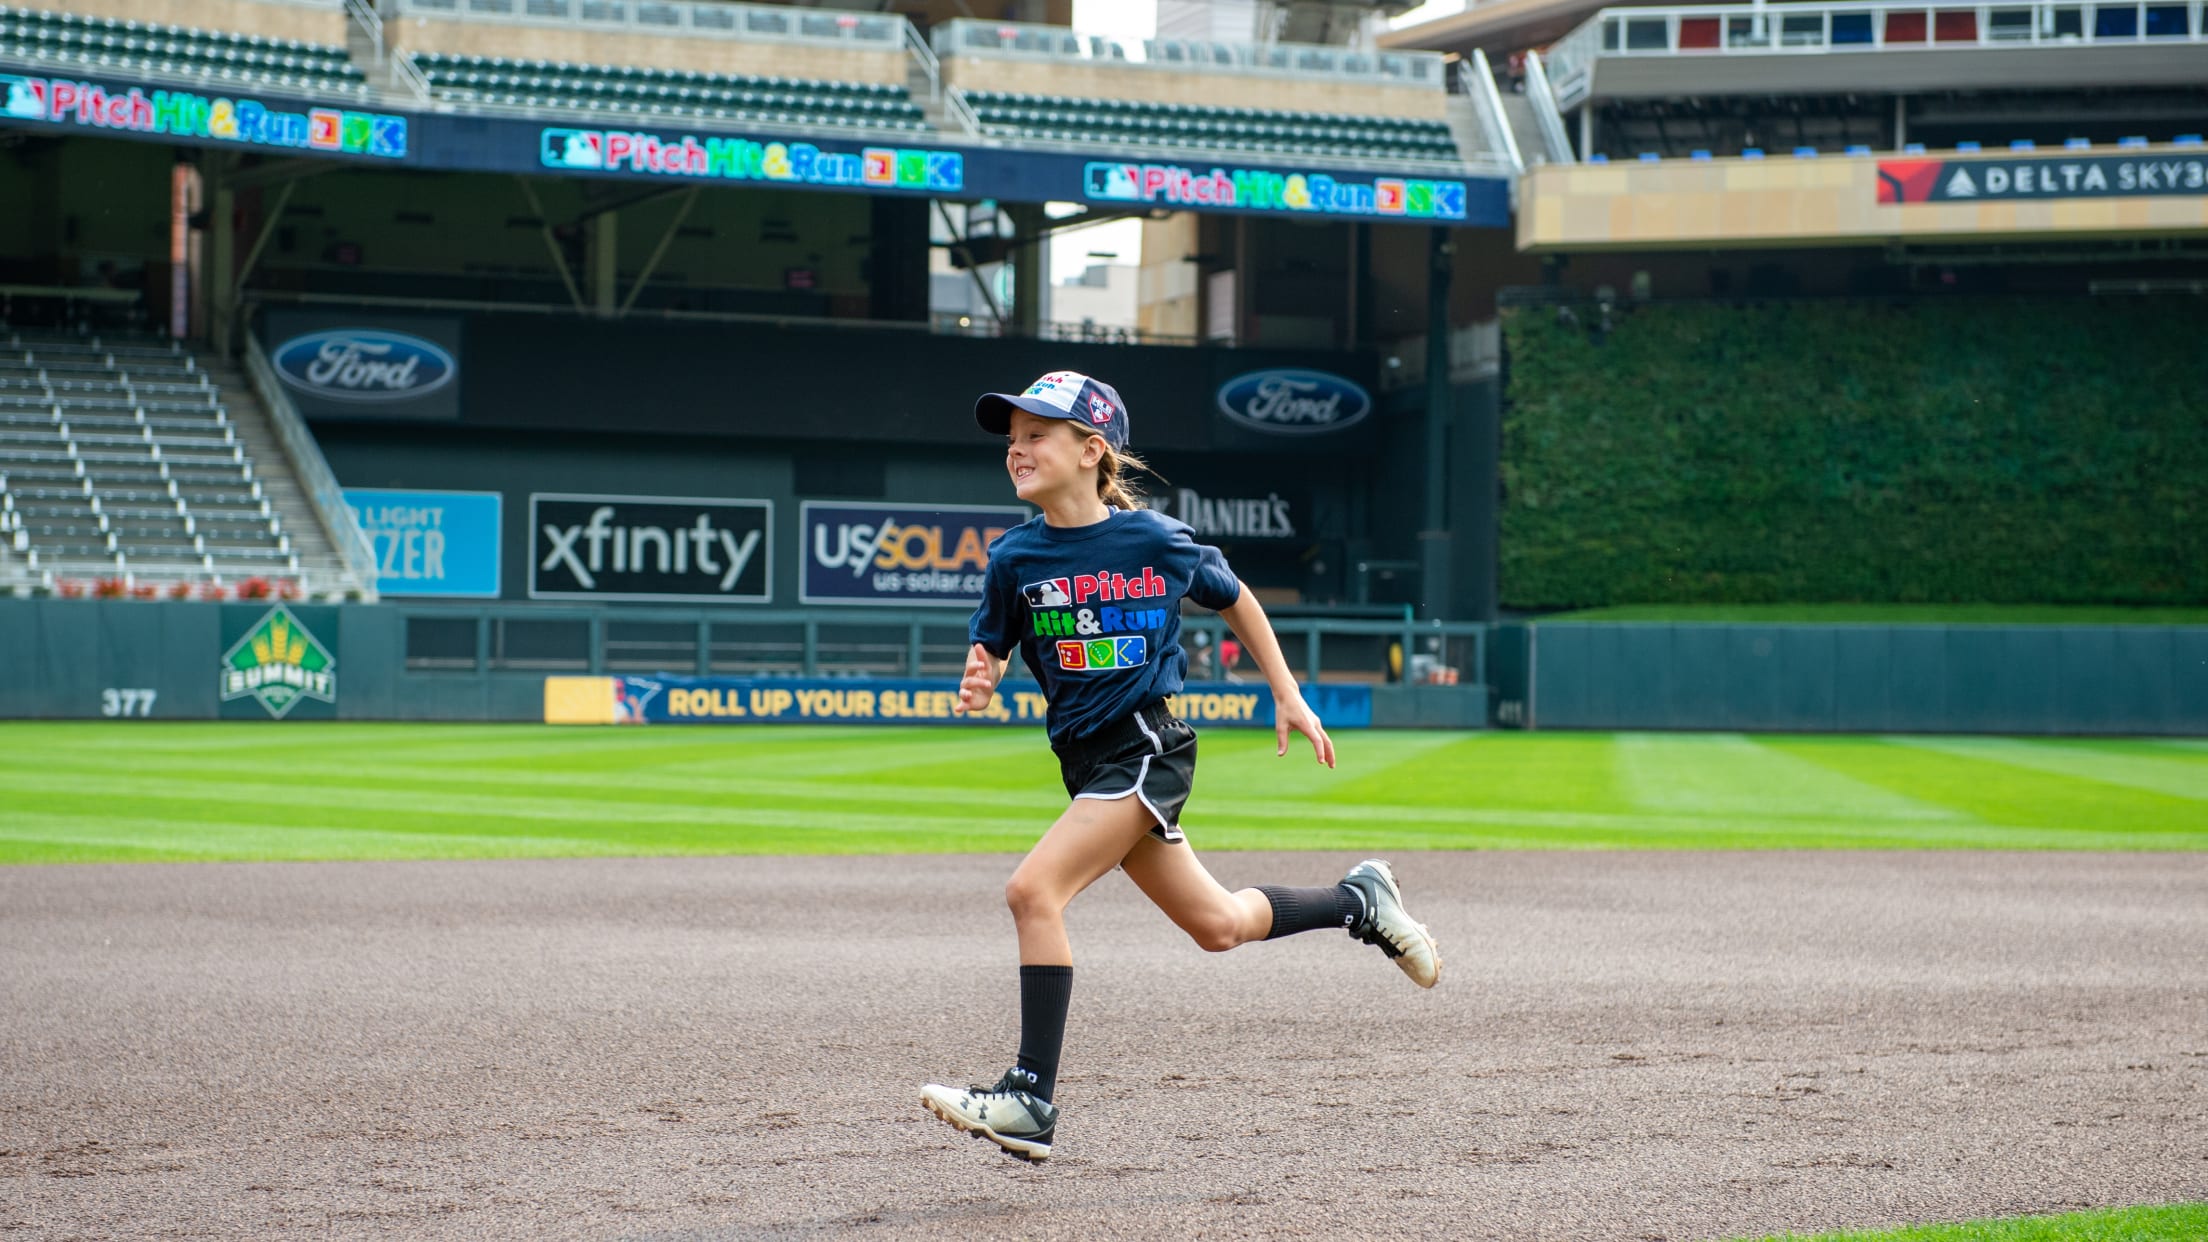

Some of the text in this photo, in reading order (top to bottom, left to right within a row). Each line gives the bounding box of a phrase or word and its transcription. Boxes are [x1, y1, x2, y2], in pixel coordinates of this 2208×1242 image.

[1985, 161, 2208, 194] DELTA SKY3
[306, 337, 420, 388] Ford
[1247, 376, 1341, 423] Ford
[366, 506, 443, 527] LIGHT
[541, 506, 761, 591] xfinity
[1074, 567, 1166, 604] Pitch
[1032, 606, 1167, 637] Hit&Run
[228, 661, 330, 696] SUMMIT
[101, 688, 157, 717] 377
[668, 688, 746, 717] ROLL
[750, 689, 793, 717] UP
[795, 690, 875, 718] YOUR
